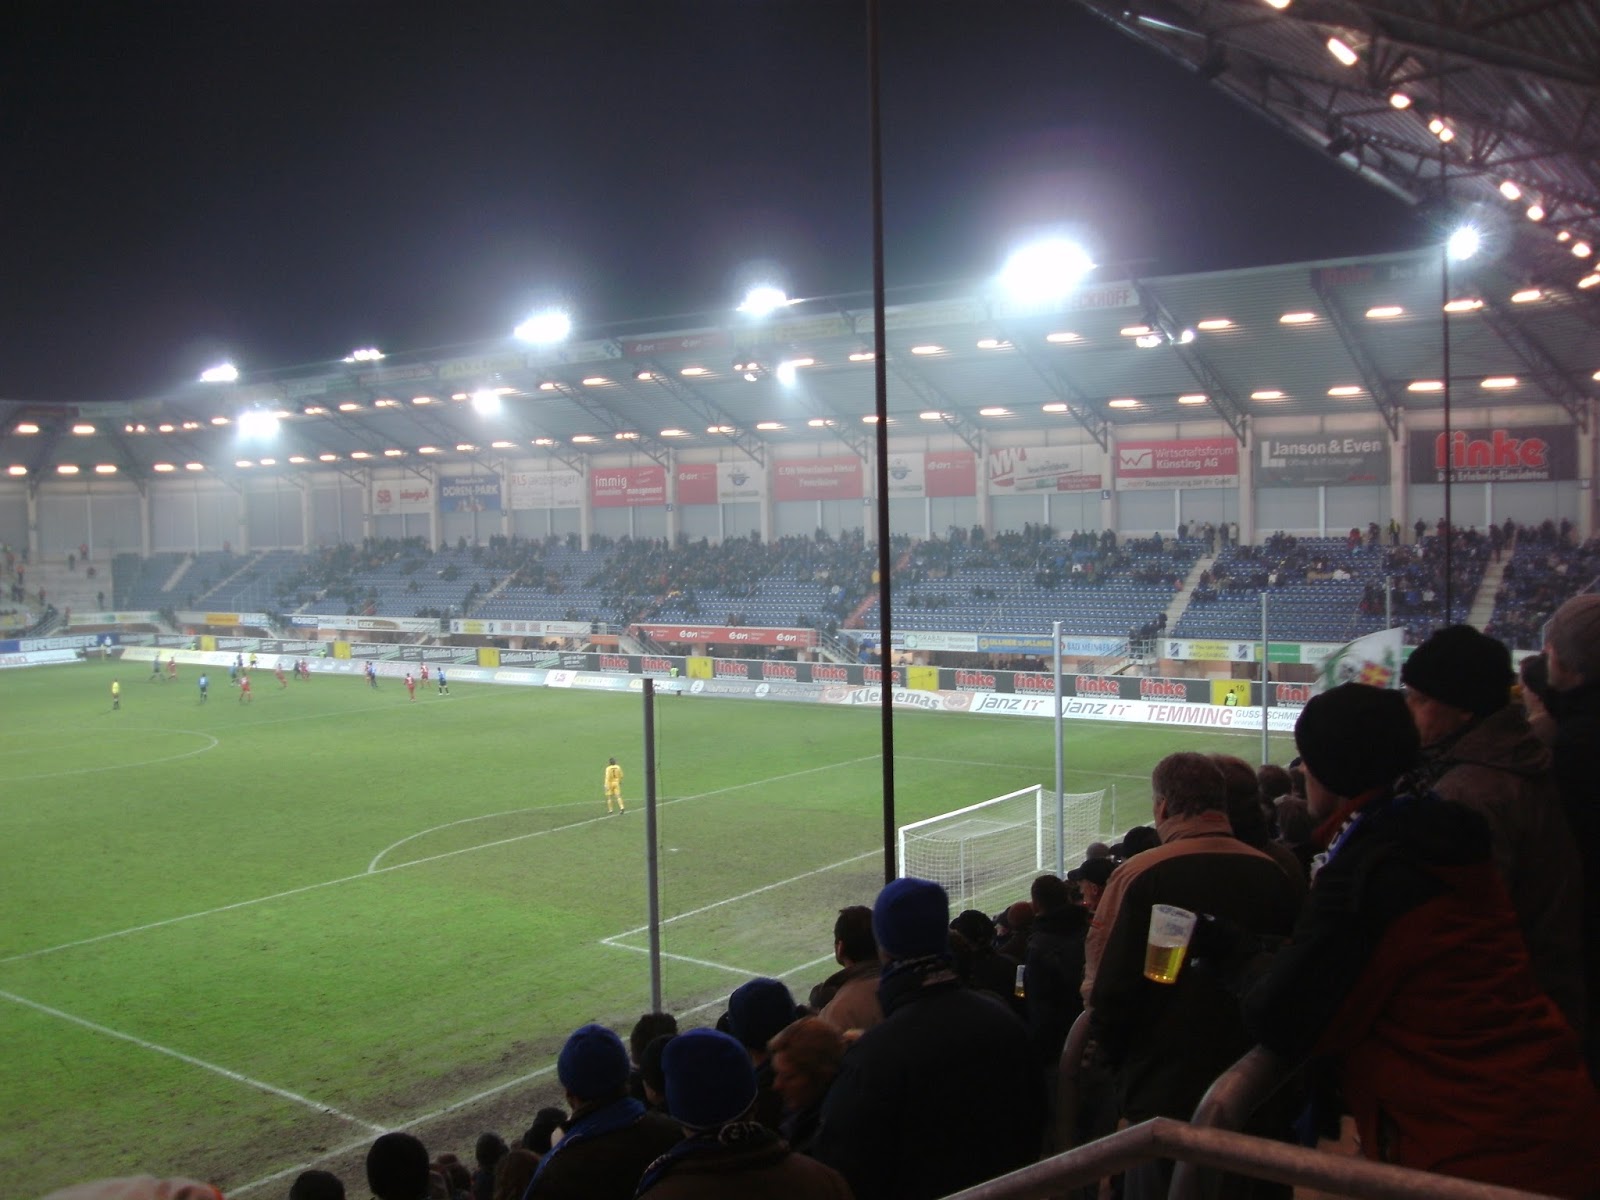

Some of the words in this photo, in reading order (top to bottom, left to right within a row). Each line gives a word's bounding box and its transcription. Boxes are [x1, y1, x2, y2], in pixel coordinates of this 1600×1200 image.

[1156, 446, 1234, 458] Wirtschaftsforum
[1273, 442, 1326, 455] Janson
[1328, 440, 1342, 454] &
[1343, 439, 1382, 453] Even
[1435, 430, 1547, 469] finke
[1156, 458, 1201, 470] Künsting
[1204, 457, 1218, 468] AG
[595, 474, 628, 489] immig
[1438, 471, 1455, 482] Ds
[600, 655, 628, 668] finke
[641, 656, 672, 671] finke
[715, 658, 748, 674] finke
[762, 662, 796, 678] finke
[811, 664, 848, 681] finke
[863, 665, 901, 682] fine
[955, 670, 996, 688] finke
[1013, 672, 1055, 690] finke
[1075, 675, 1120, 694] finke
[1139, 678, 1187, 697] finke
[851, 689, 940, 710] Kleemas
[975, 693, 1022, 712] janz
[1061, 698, 1109, 717] janz
[1147, 704, 1234, 726] TEMMING
